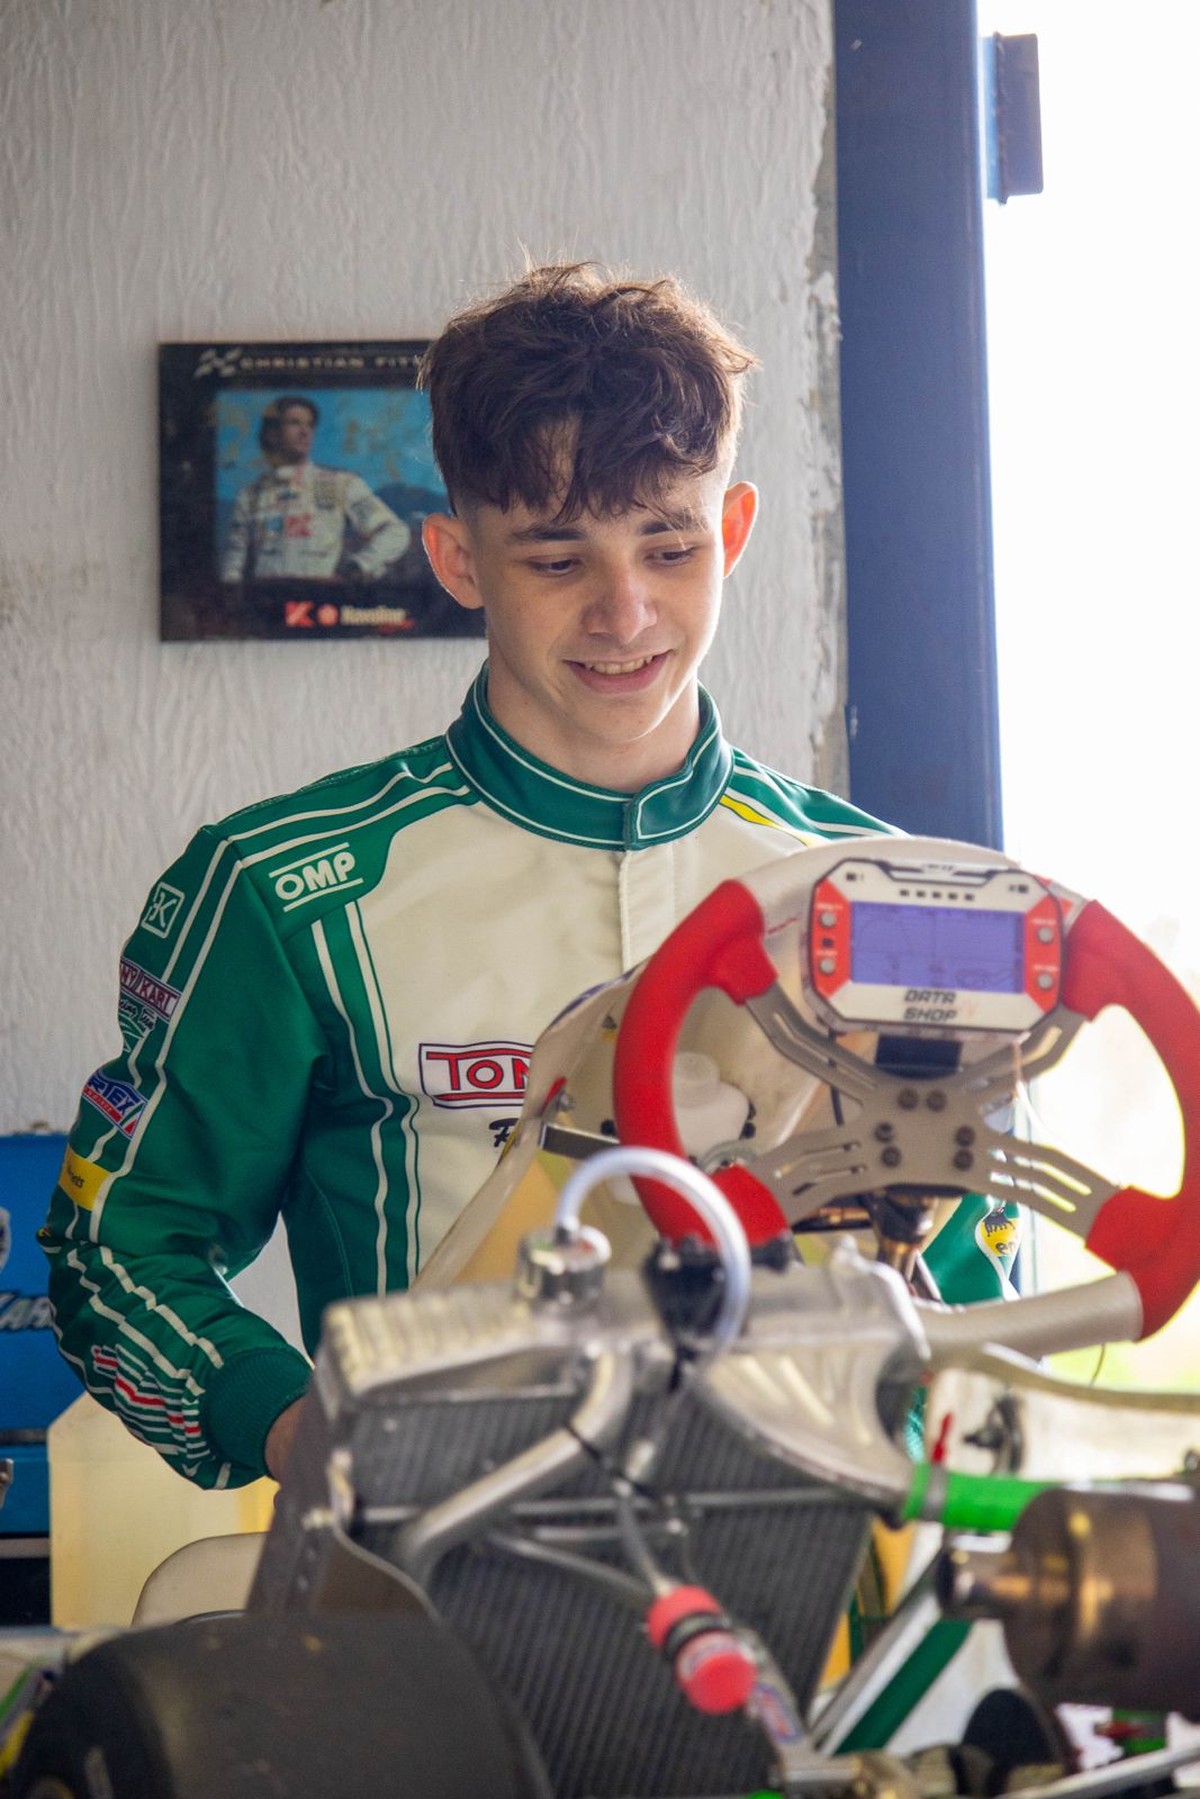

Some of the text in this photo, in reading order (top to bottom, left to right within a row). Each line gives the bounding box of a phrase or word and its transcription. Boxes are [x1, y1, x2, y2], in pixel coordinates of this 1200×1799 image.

[240, 356, 364, 369] CHRISTIAN
[275, 851, 356, 901] OMP
[139, 976, 177, 1013] KART
[905, 989, 957, 1003] DATA
[904, 1007, 957, 1021] SHOP
